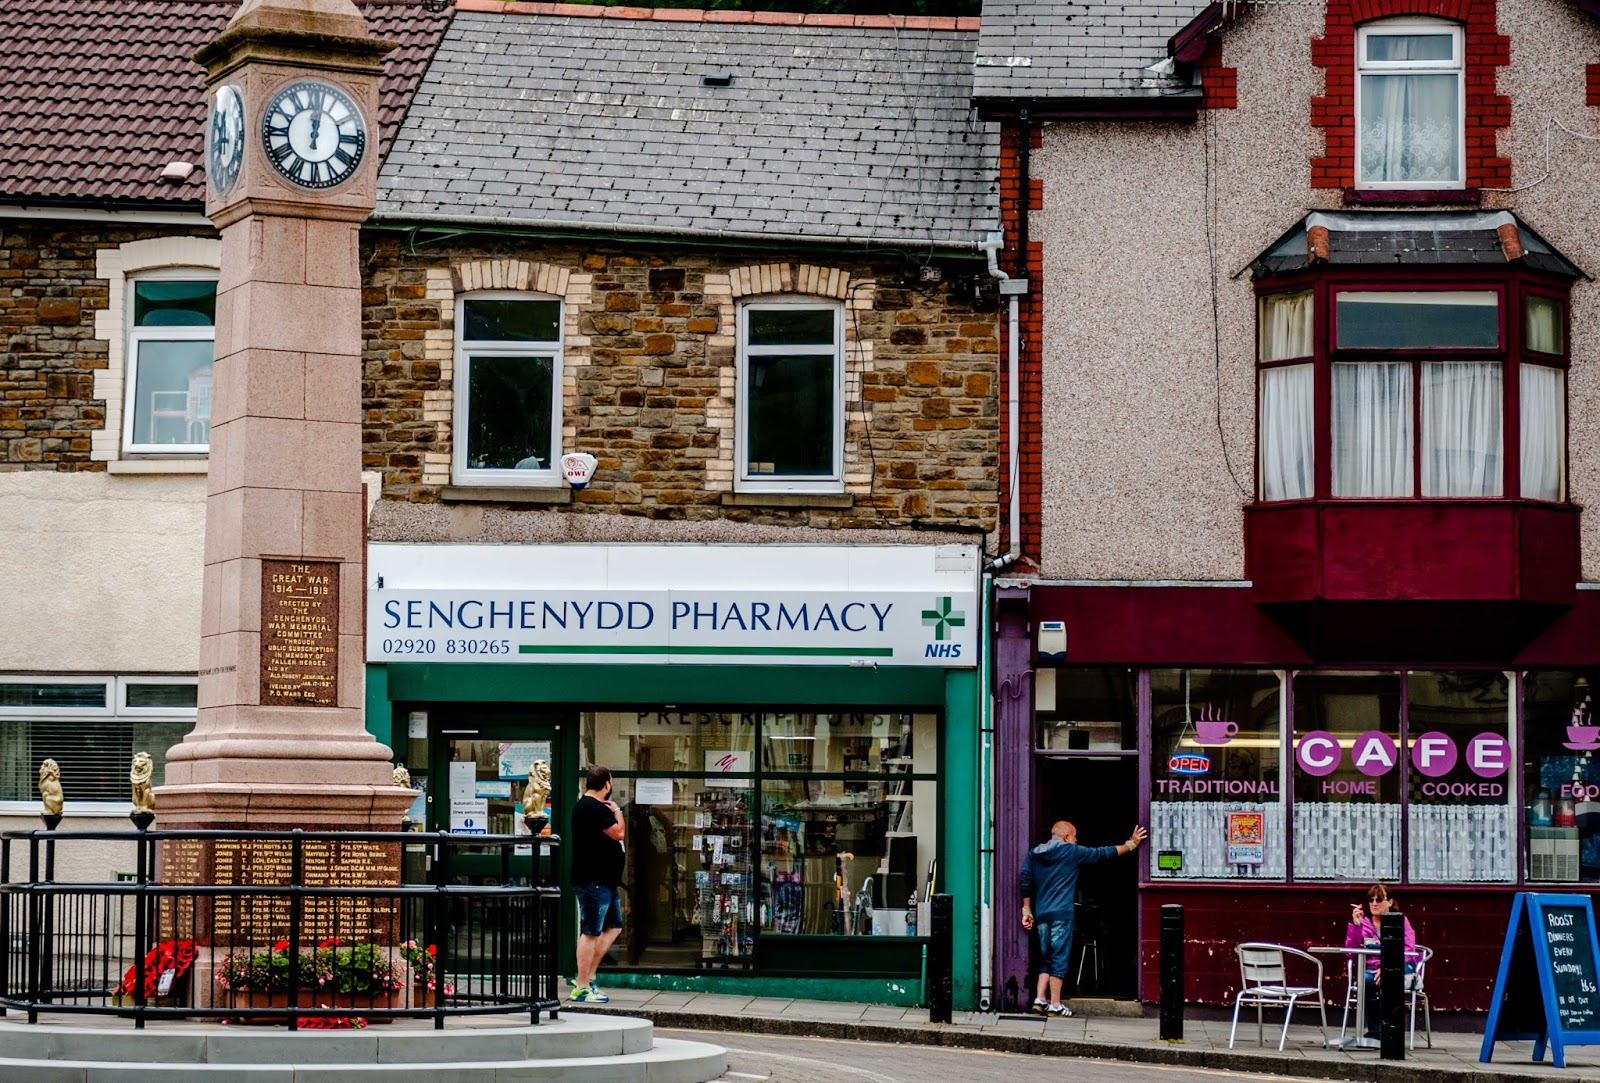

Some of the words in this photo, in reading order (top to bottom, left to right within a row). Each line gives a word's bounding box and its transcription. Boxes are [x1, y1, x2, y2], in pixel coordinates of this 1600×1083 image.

[291, 565, 310, 573] THE
[273, 575, 302, 583] GREAT
[383, 600, 654, 630] SENGHENYDD
[671, 602, 894, 632] PHARMACY
[382, 638, 436, 654] 02920
[446, 638, 510, 655] 830265
[924, 644, 962, 658] NHS
[1169, 758, 1210, 771] OPEN
[1157, 780, 1279, 794] TRADITIONAL
[1322, 781, 1376, 795] HOME
[1422, 782, 1503, 796] COOKED
